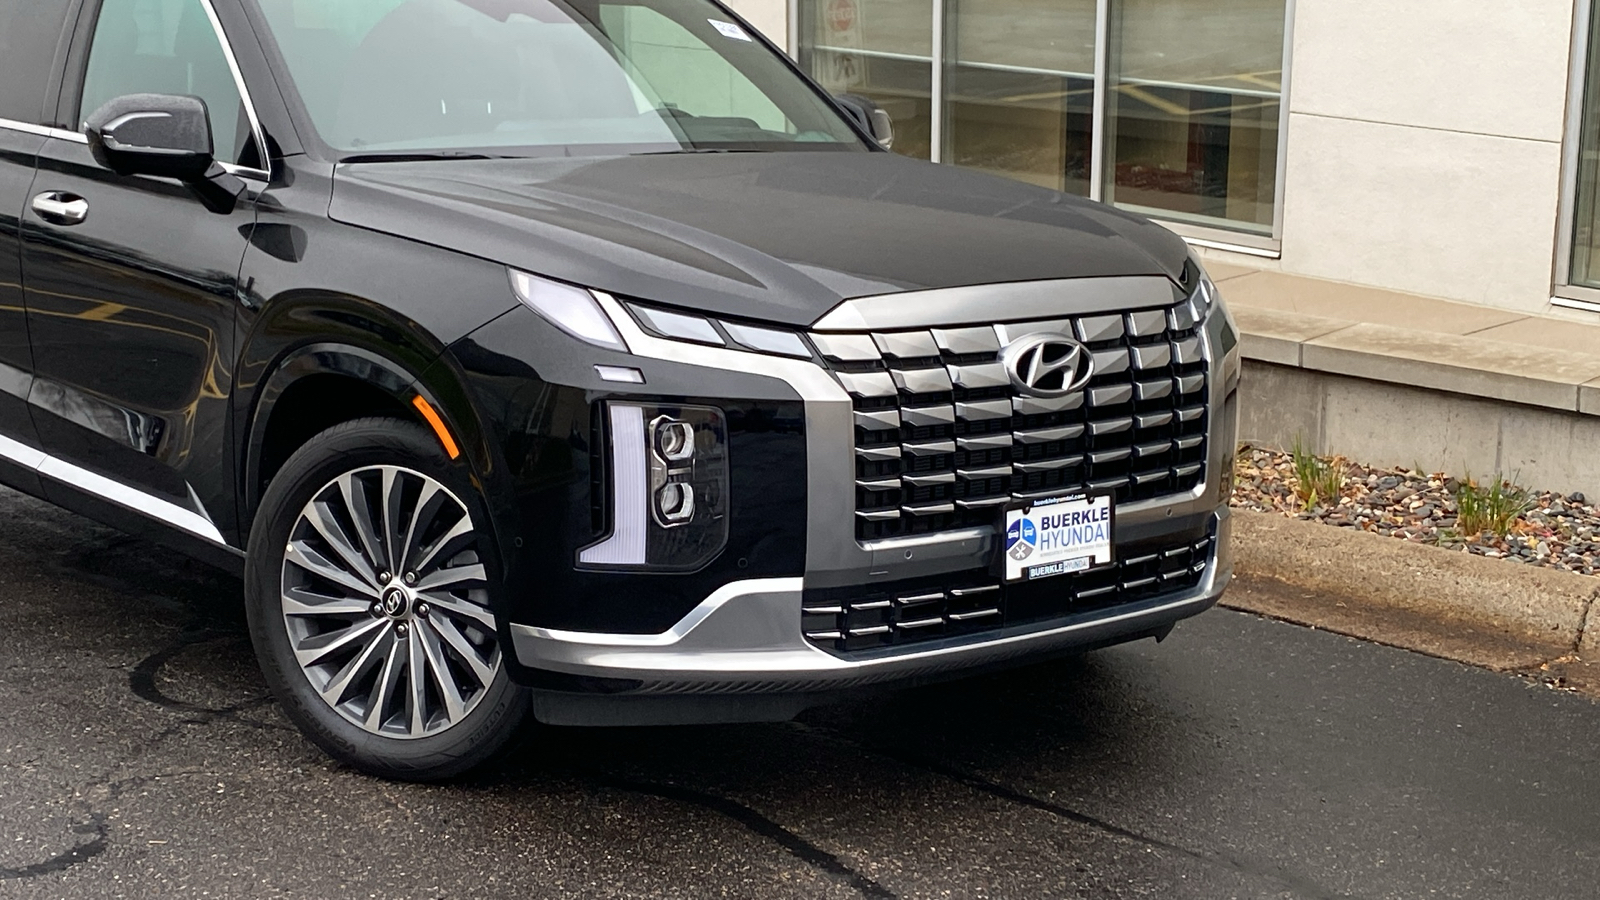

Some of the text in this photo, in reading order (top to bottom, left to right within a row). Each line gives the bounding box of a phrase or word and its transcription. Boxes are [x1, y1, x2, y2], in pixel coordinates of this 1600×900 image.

[1041, 507, 1108, 531] BUERKLE
[1040, 522, 1109, 551] HYUNDAI
[1030, 559, 1087, 577] BUERKLE HYUNDAI
[466, 701, 507, 746] OUTSIDE
